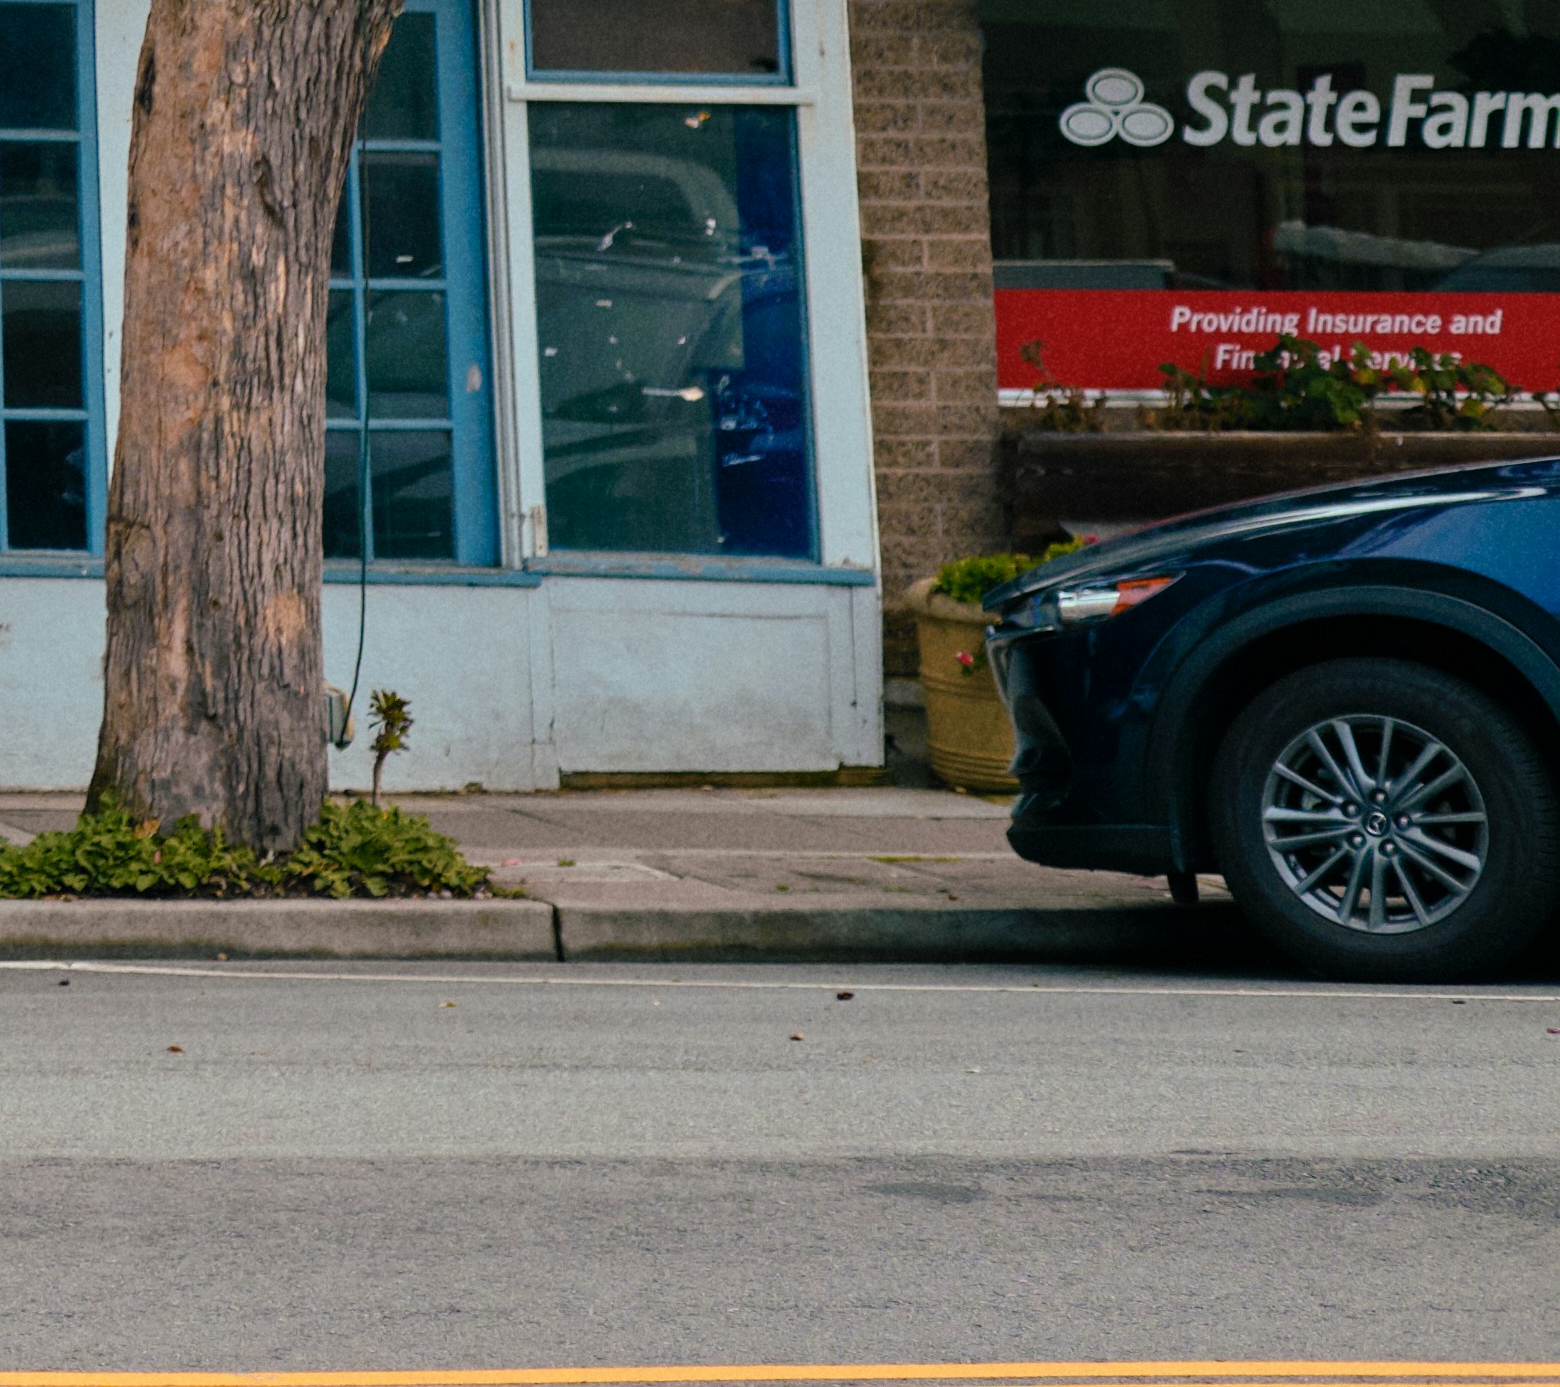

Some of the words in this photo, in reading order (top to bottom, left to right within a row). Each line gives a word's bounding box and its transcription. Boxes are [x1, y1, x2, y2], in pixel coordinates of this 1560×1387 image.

[1171, 306, 1301, 337] Providing
[1307, 307, 1442, 335] Insurance
[1449, 308, 1504, 335] and
